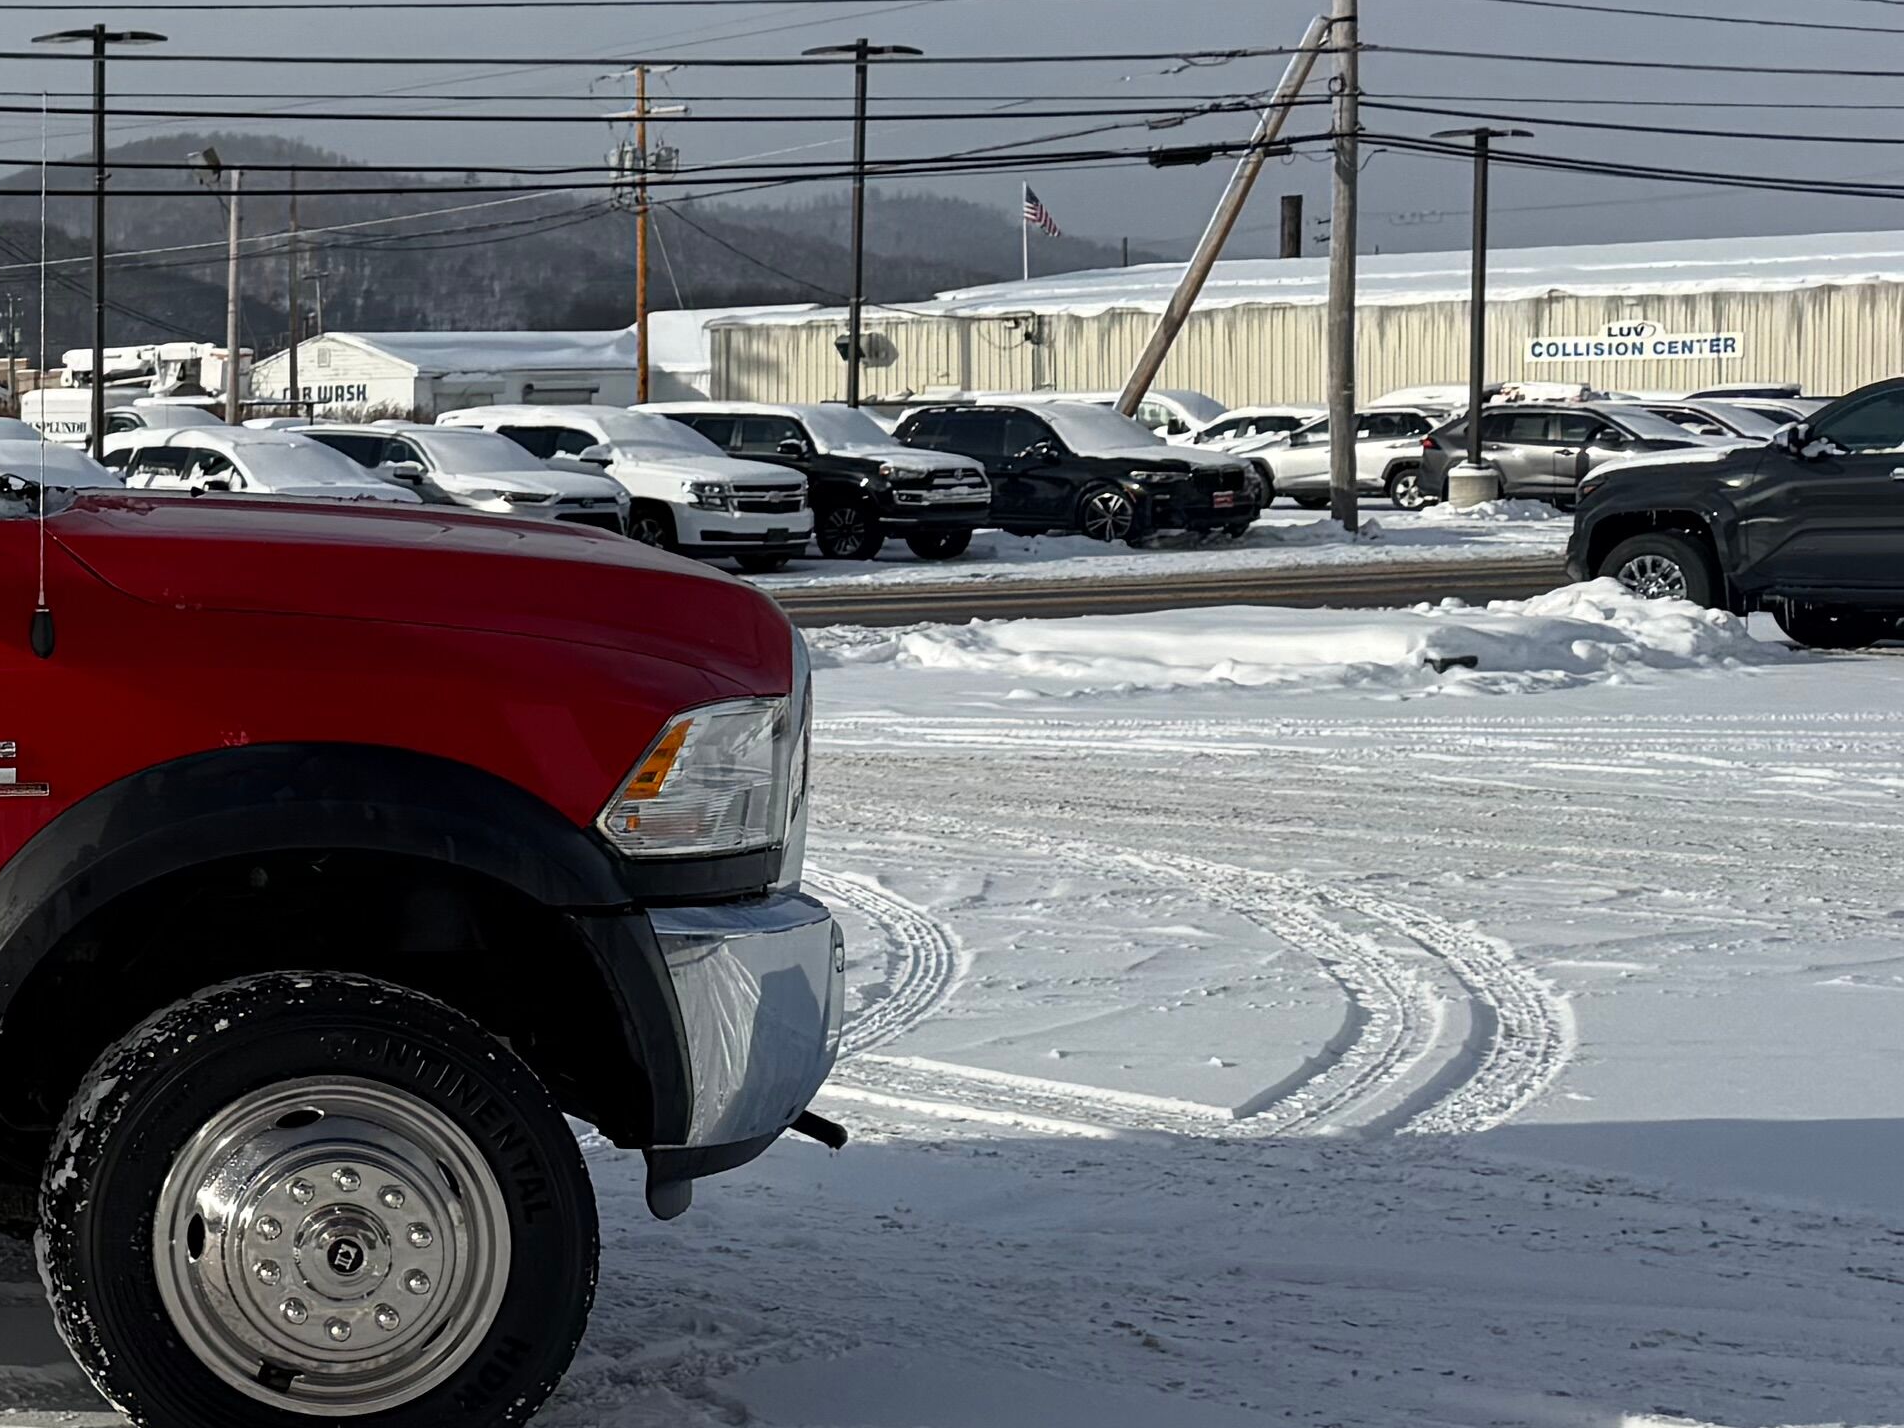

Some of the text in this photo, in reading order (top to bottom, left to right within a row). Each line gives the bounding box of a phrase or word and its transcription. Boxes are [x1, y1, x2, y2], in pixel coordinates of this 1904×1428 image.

[1607, 325, 1646, 338] LUV
[1530, 336, 1737, 358] COLLISION CENTER
[283, 383, 367, 403] CR WASH
